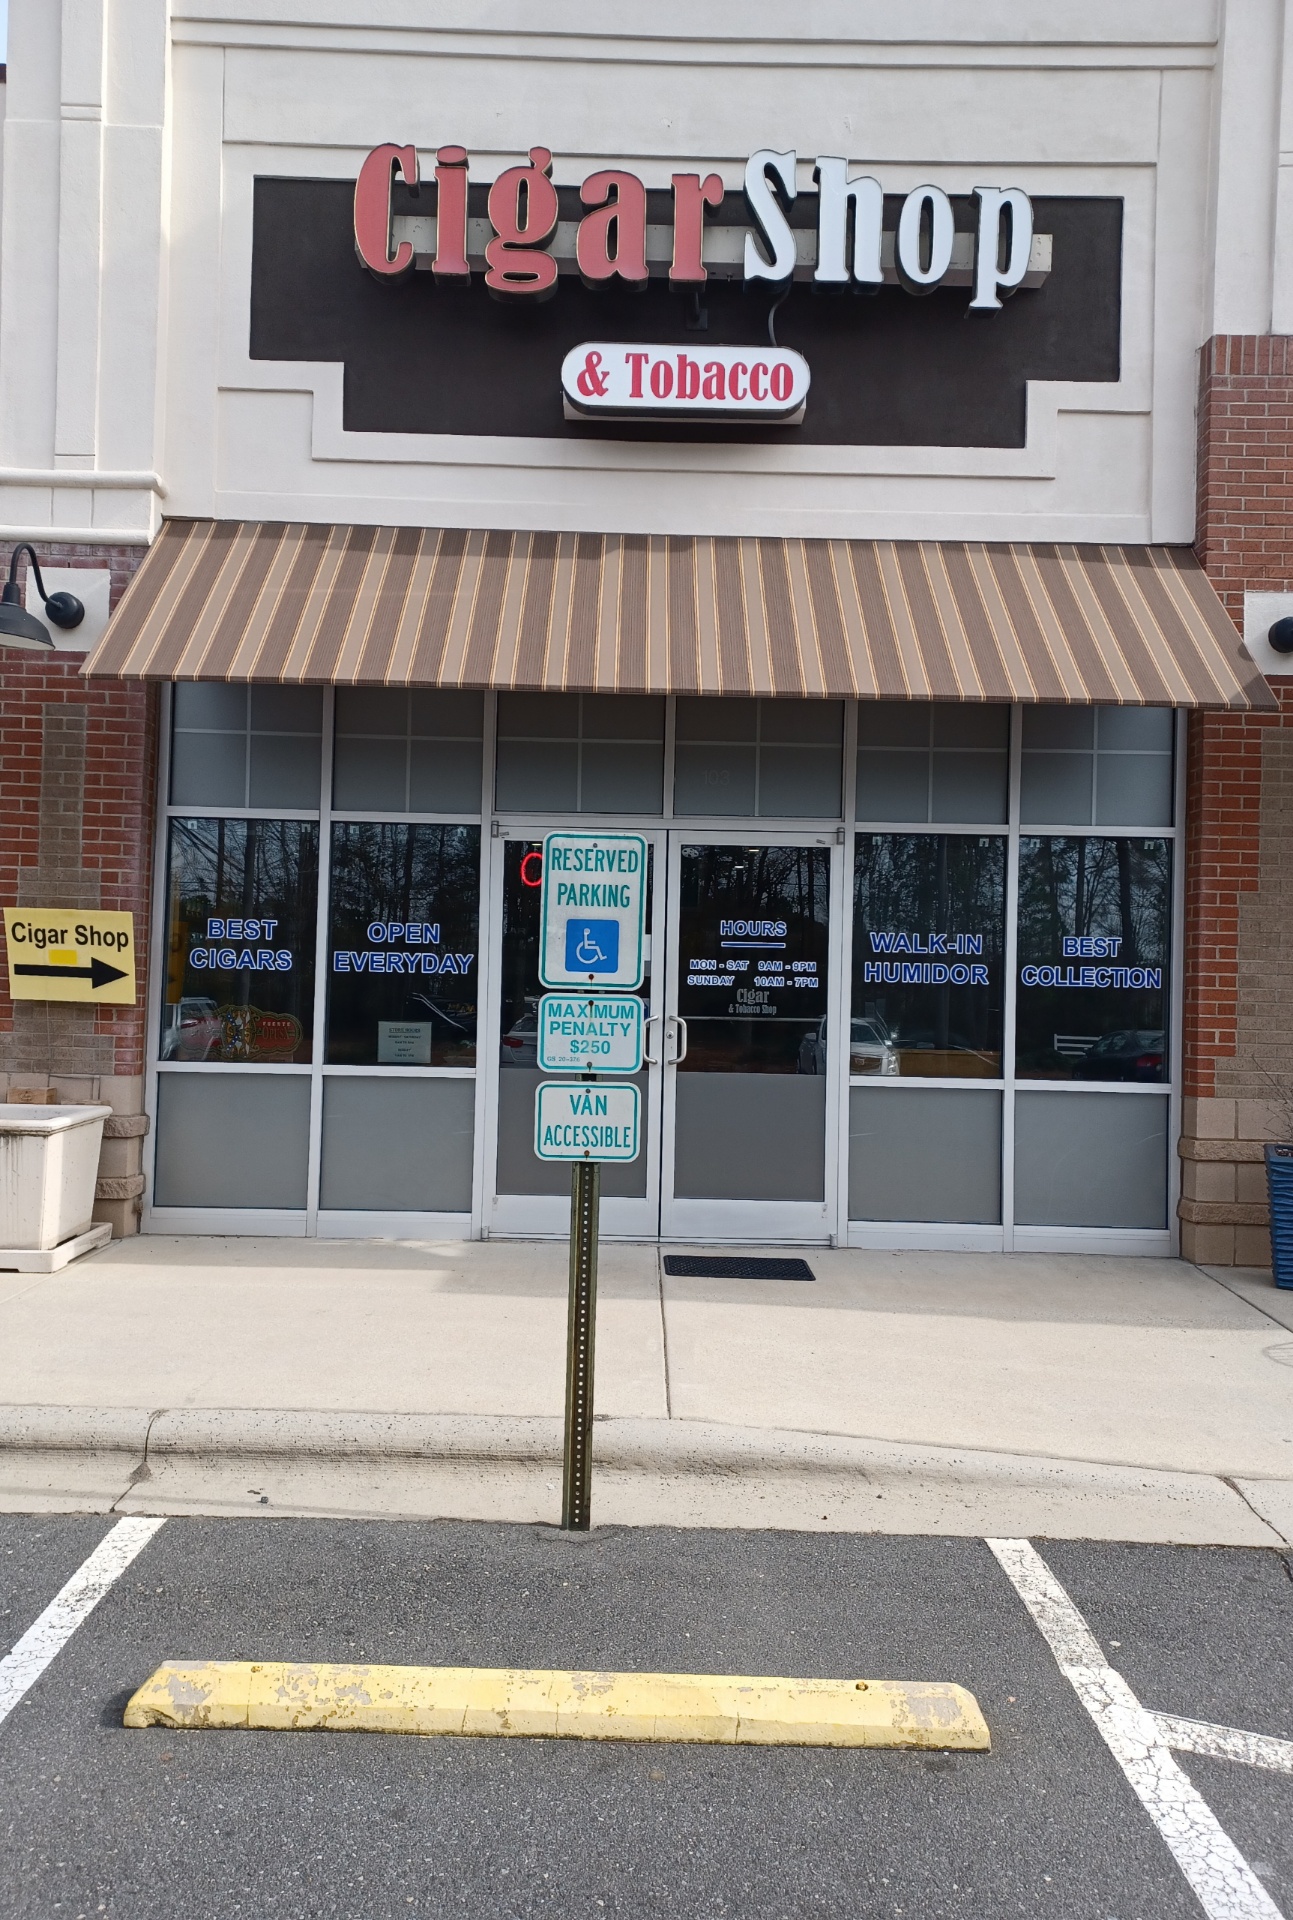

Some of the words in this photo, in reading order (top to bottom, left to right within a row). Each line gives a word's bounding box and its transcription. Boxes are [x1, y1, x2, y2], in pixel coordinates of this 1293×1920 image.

[353, 142, 725, 295] Cigar
[743, 148, 1034, 311] Shop
[576, 351, 610, 397] &
[624, 351, 796, 402] Tobacco
[702, 769, 731, 786] 103
[552, 848, 639, 873] RESERVED
[557, 882, 631, 909] PARKING
[10, 921, 70, 947] Cigar
[74, 924, 130, 952] Shop
[206, 917, 278, 941] BEST
[366, 921, 441, 945] OPEN
[720, 919, 788, 937] HOURS
[869, 932, 983, 955] WALK-IN
[1062, 936, 1123, 958] BEST
[189, 947, 293, 971] CIGARS
[333, 950, 475, 975] EVERYDAY
[690, 959, 717, 970] MON
[726, 959, 749, 971] SAT
[757, 961, 783, 972] 9AM
[792, 961, 817, 973] 9PM
[687, 974, 735, 986] SUNDAY
[753, 976, 784, 988] 10AM
[794, 977, 819, 988] 7PM
[863, 962, 990, 985] HUMIDOR
[1021, 965, 1162, 990] COLLECTION
[737, 988, 770, 1004] Cigar
[547, 1002, 635, 1021] MAXIMUM
[728, 1004, 735, 1014] &
[735, 1004, 760, 1014] Tobacco
[762, 1004, 778, 1015] Shop
[549, 1022, 632, 1038] PENALTY
[569, 1040, 611, 1055] $250
[569, 1094, 608, 1116] VAN
[543, 1124, 632, 1149] ACCESSIBLE
